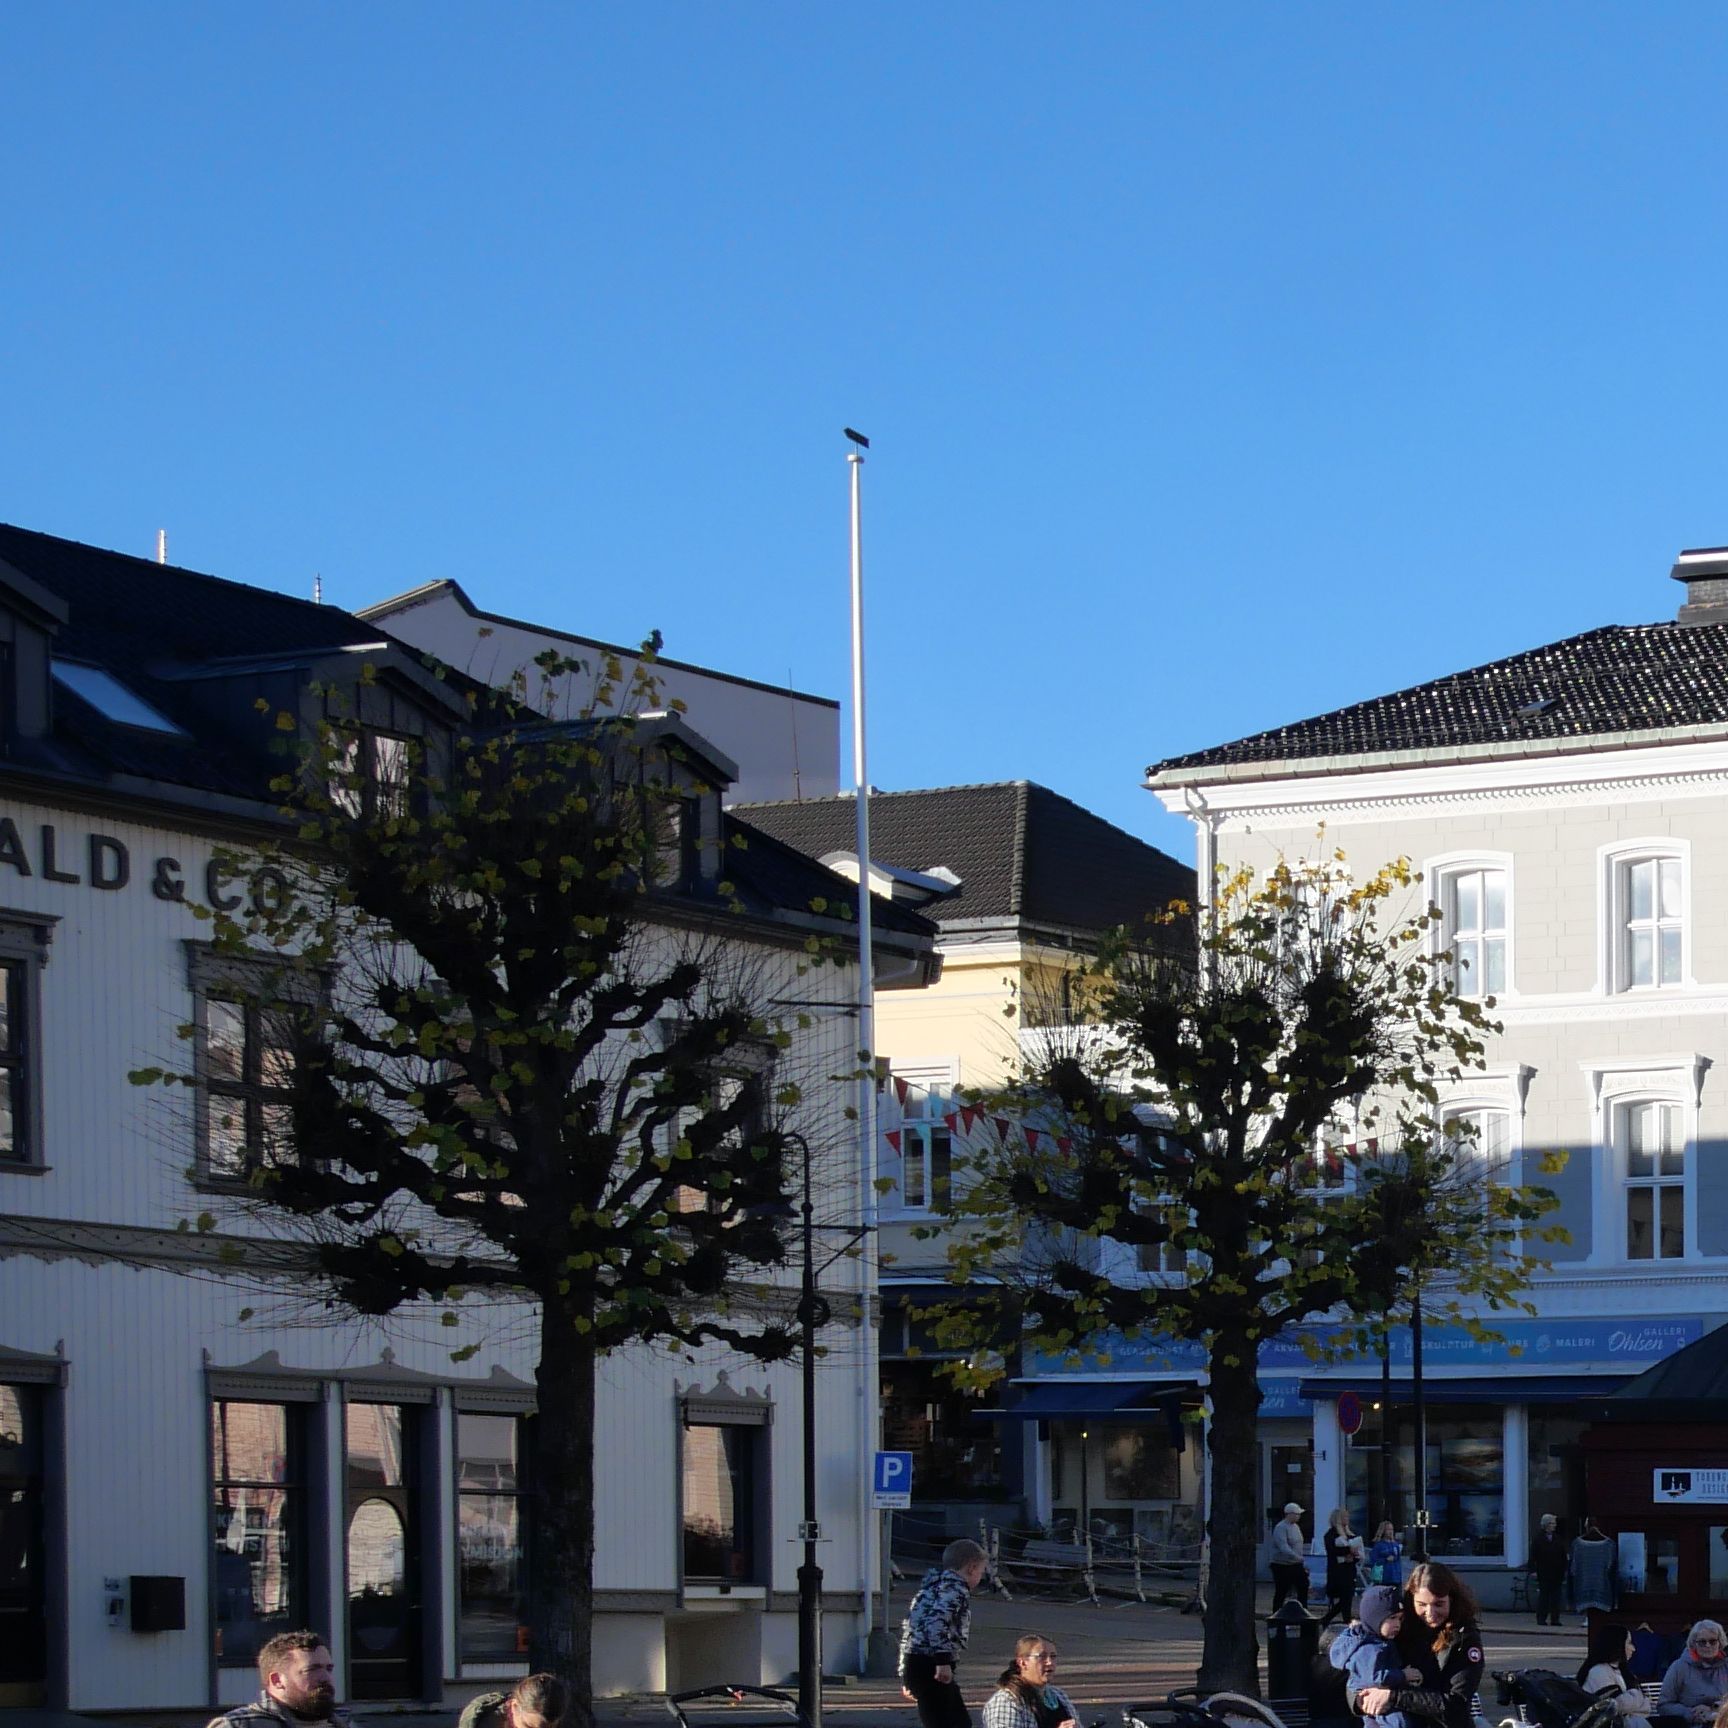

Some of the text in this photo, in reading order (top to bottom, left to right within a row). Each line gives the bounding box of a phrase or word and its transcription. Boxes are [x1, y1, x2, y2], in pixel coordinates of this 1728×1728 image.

[153, 857, 184, 902] &
[1608, 1331, 1664, 1352] Ohlsen
[1644, 1327, 1686, 1336] GALLERI
[1556, 1338, 1596, 1347] MALERI
[882, 1456, 903, 1488] P
